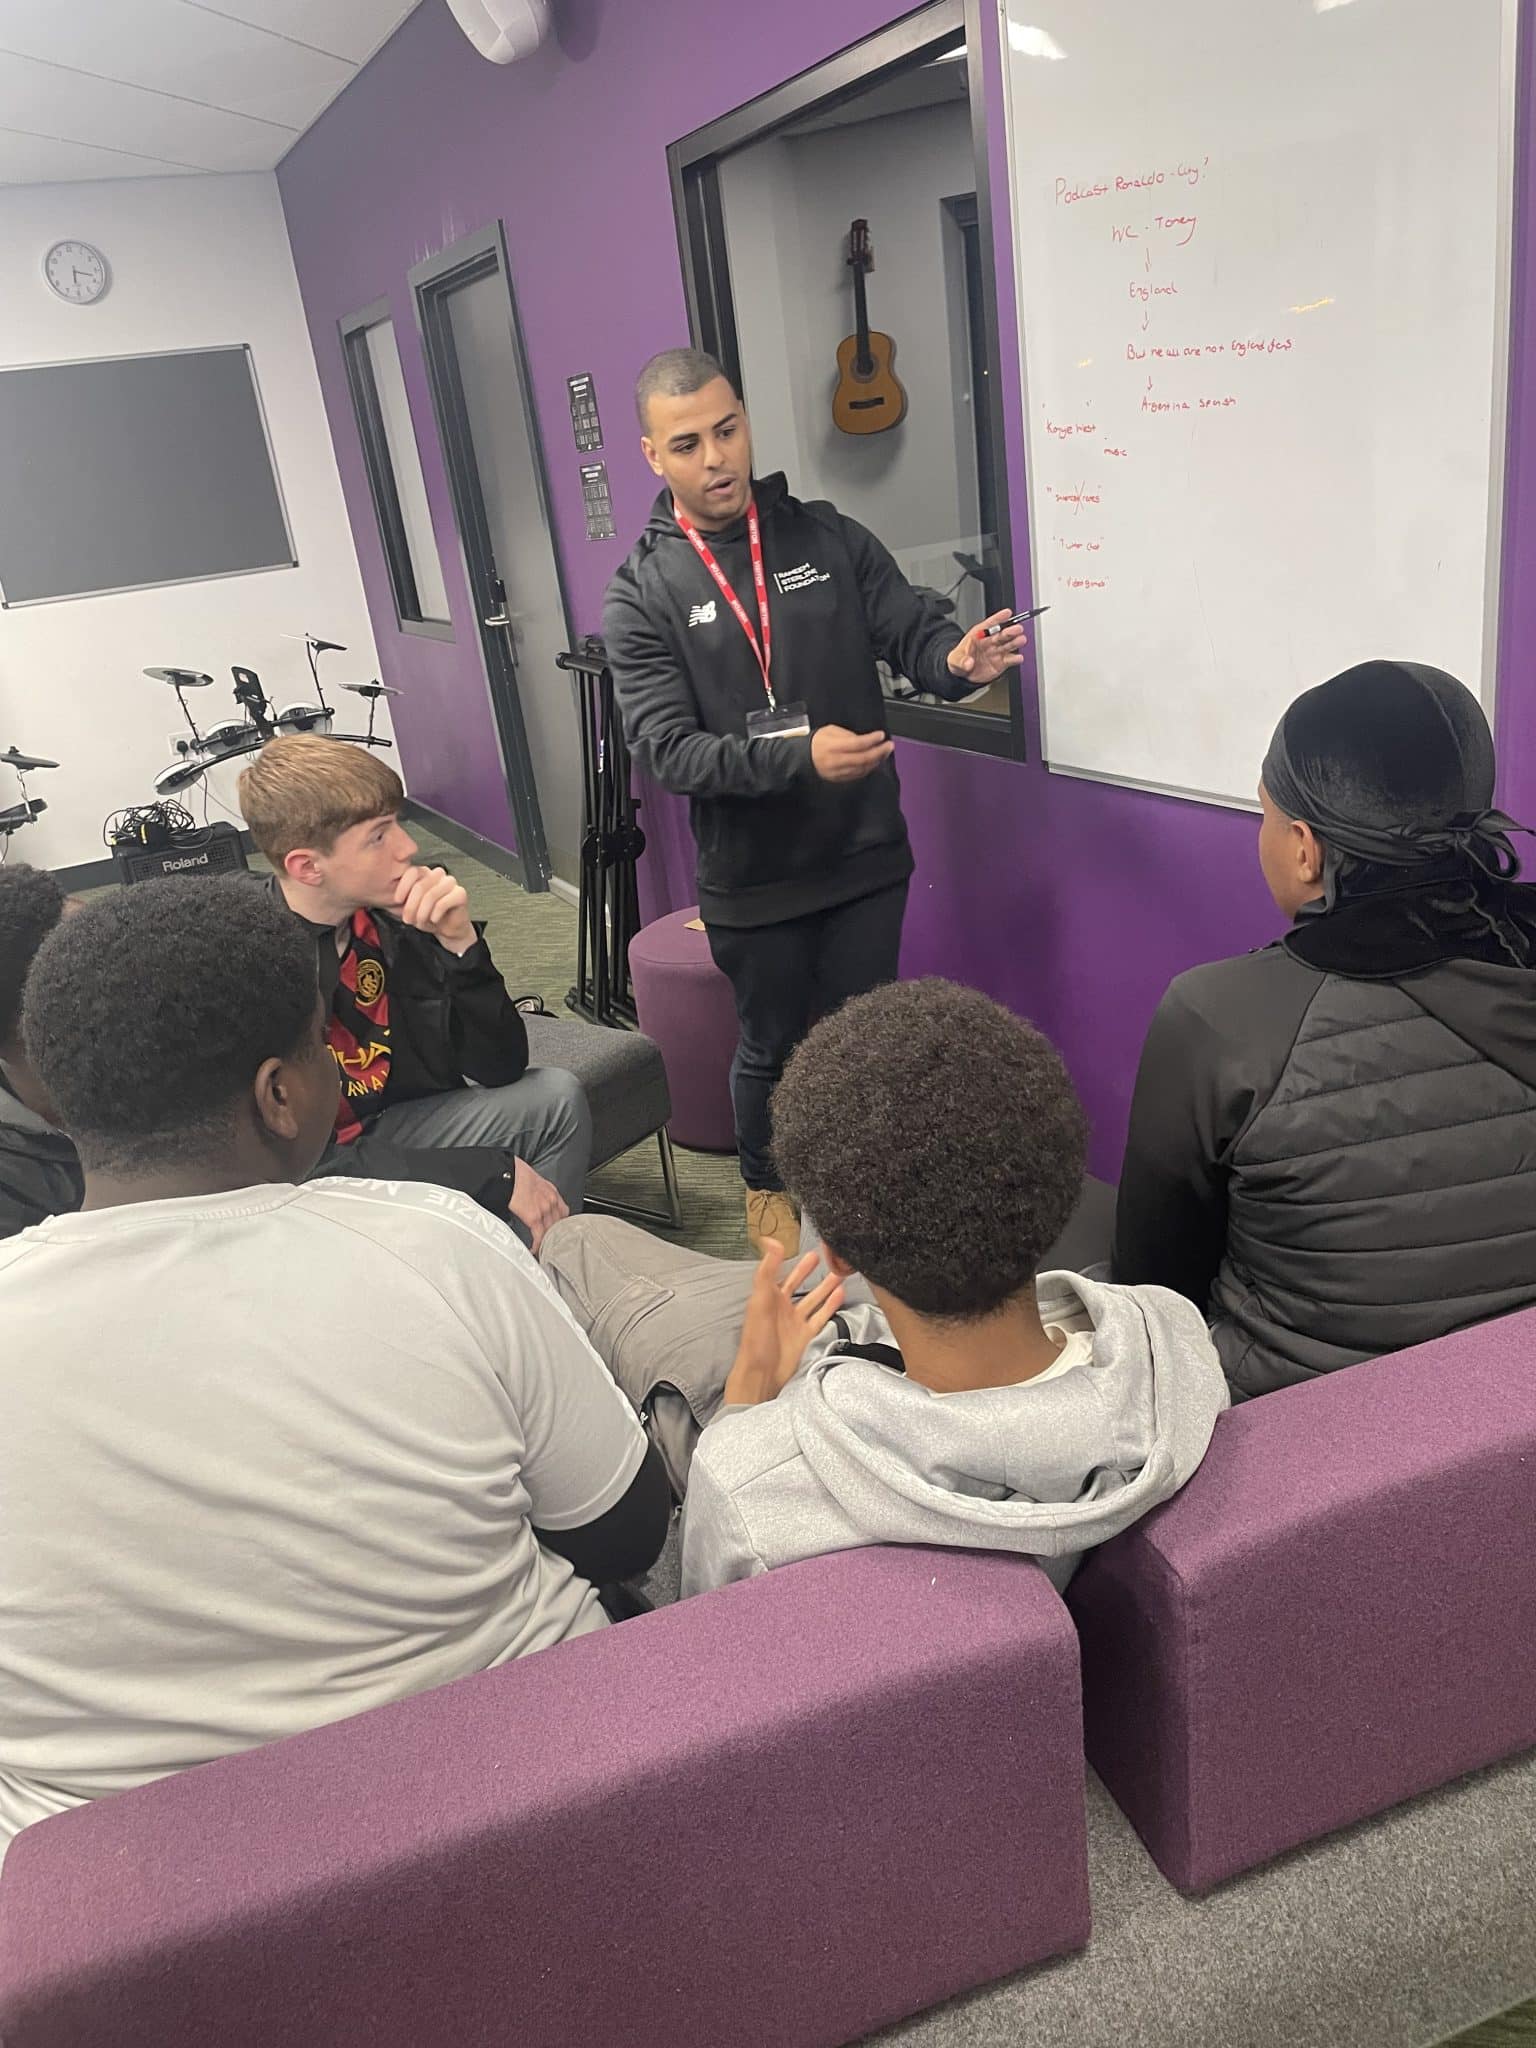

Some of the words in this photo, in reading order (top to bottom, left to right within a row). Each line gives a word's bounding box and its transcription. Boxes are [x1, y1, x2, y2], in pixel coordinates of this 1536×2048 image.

[1055, 176, 1109, 206] Podcast
[1115, 170, 1165, 191] Ronaldo
[1111, 225, 1139, 243] WC
[1154, 216, 1197, 247] Toney
[1129, 281, 1178, 302] England
[1231, 339, 1265, 357] England
[162, 852, 210, 873] Roland
